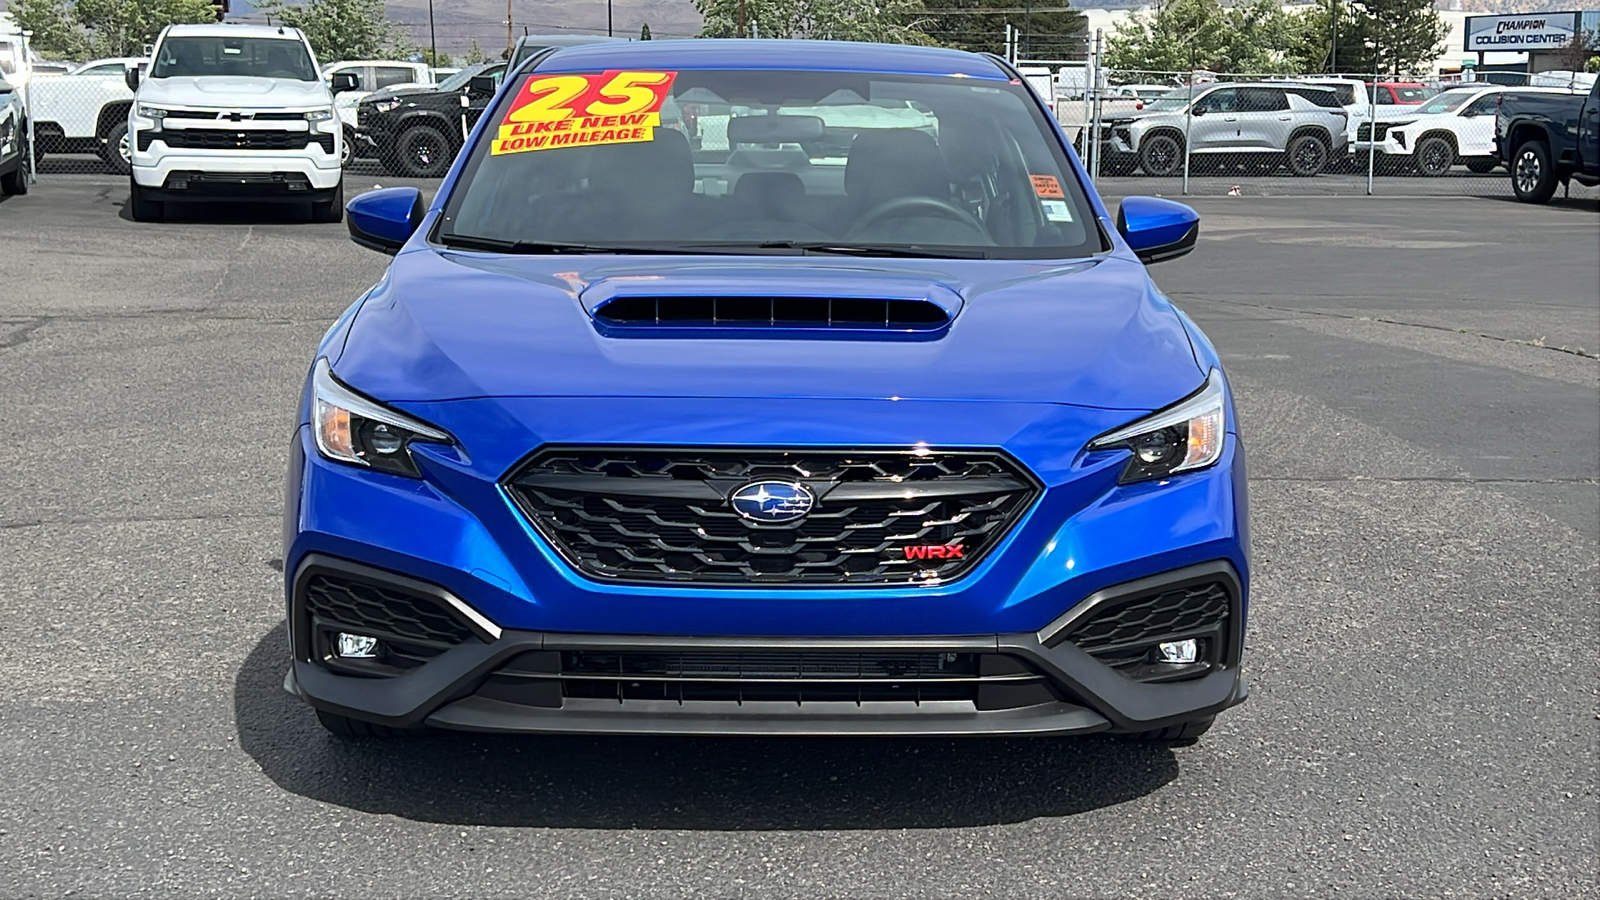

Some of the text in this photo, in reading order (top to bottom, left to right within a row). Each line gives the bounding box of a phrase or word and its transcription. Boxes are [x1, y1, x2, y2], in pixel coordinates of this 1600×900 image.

[1496, 19, 1546, 35] CHAMPION
[1475, 33, 1567, 45] COLLISION CENTER
[509, 71, 670, 122] 25
[510, 113, 649, 136] LIKE NEW
[499, 127, 646, 151] LOW MILEAGE
[904, 544, 964, 559] WRX
